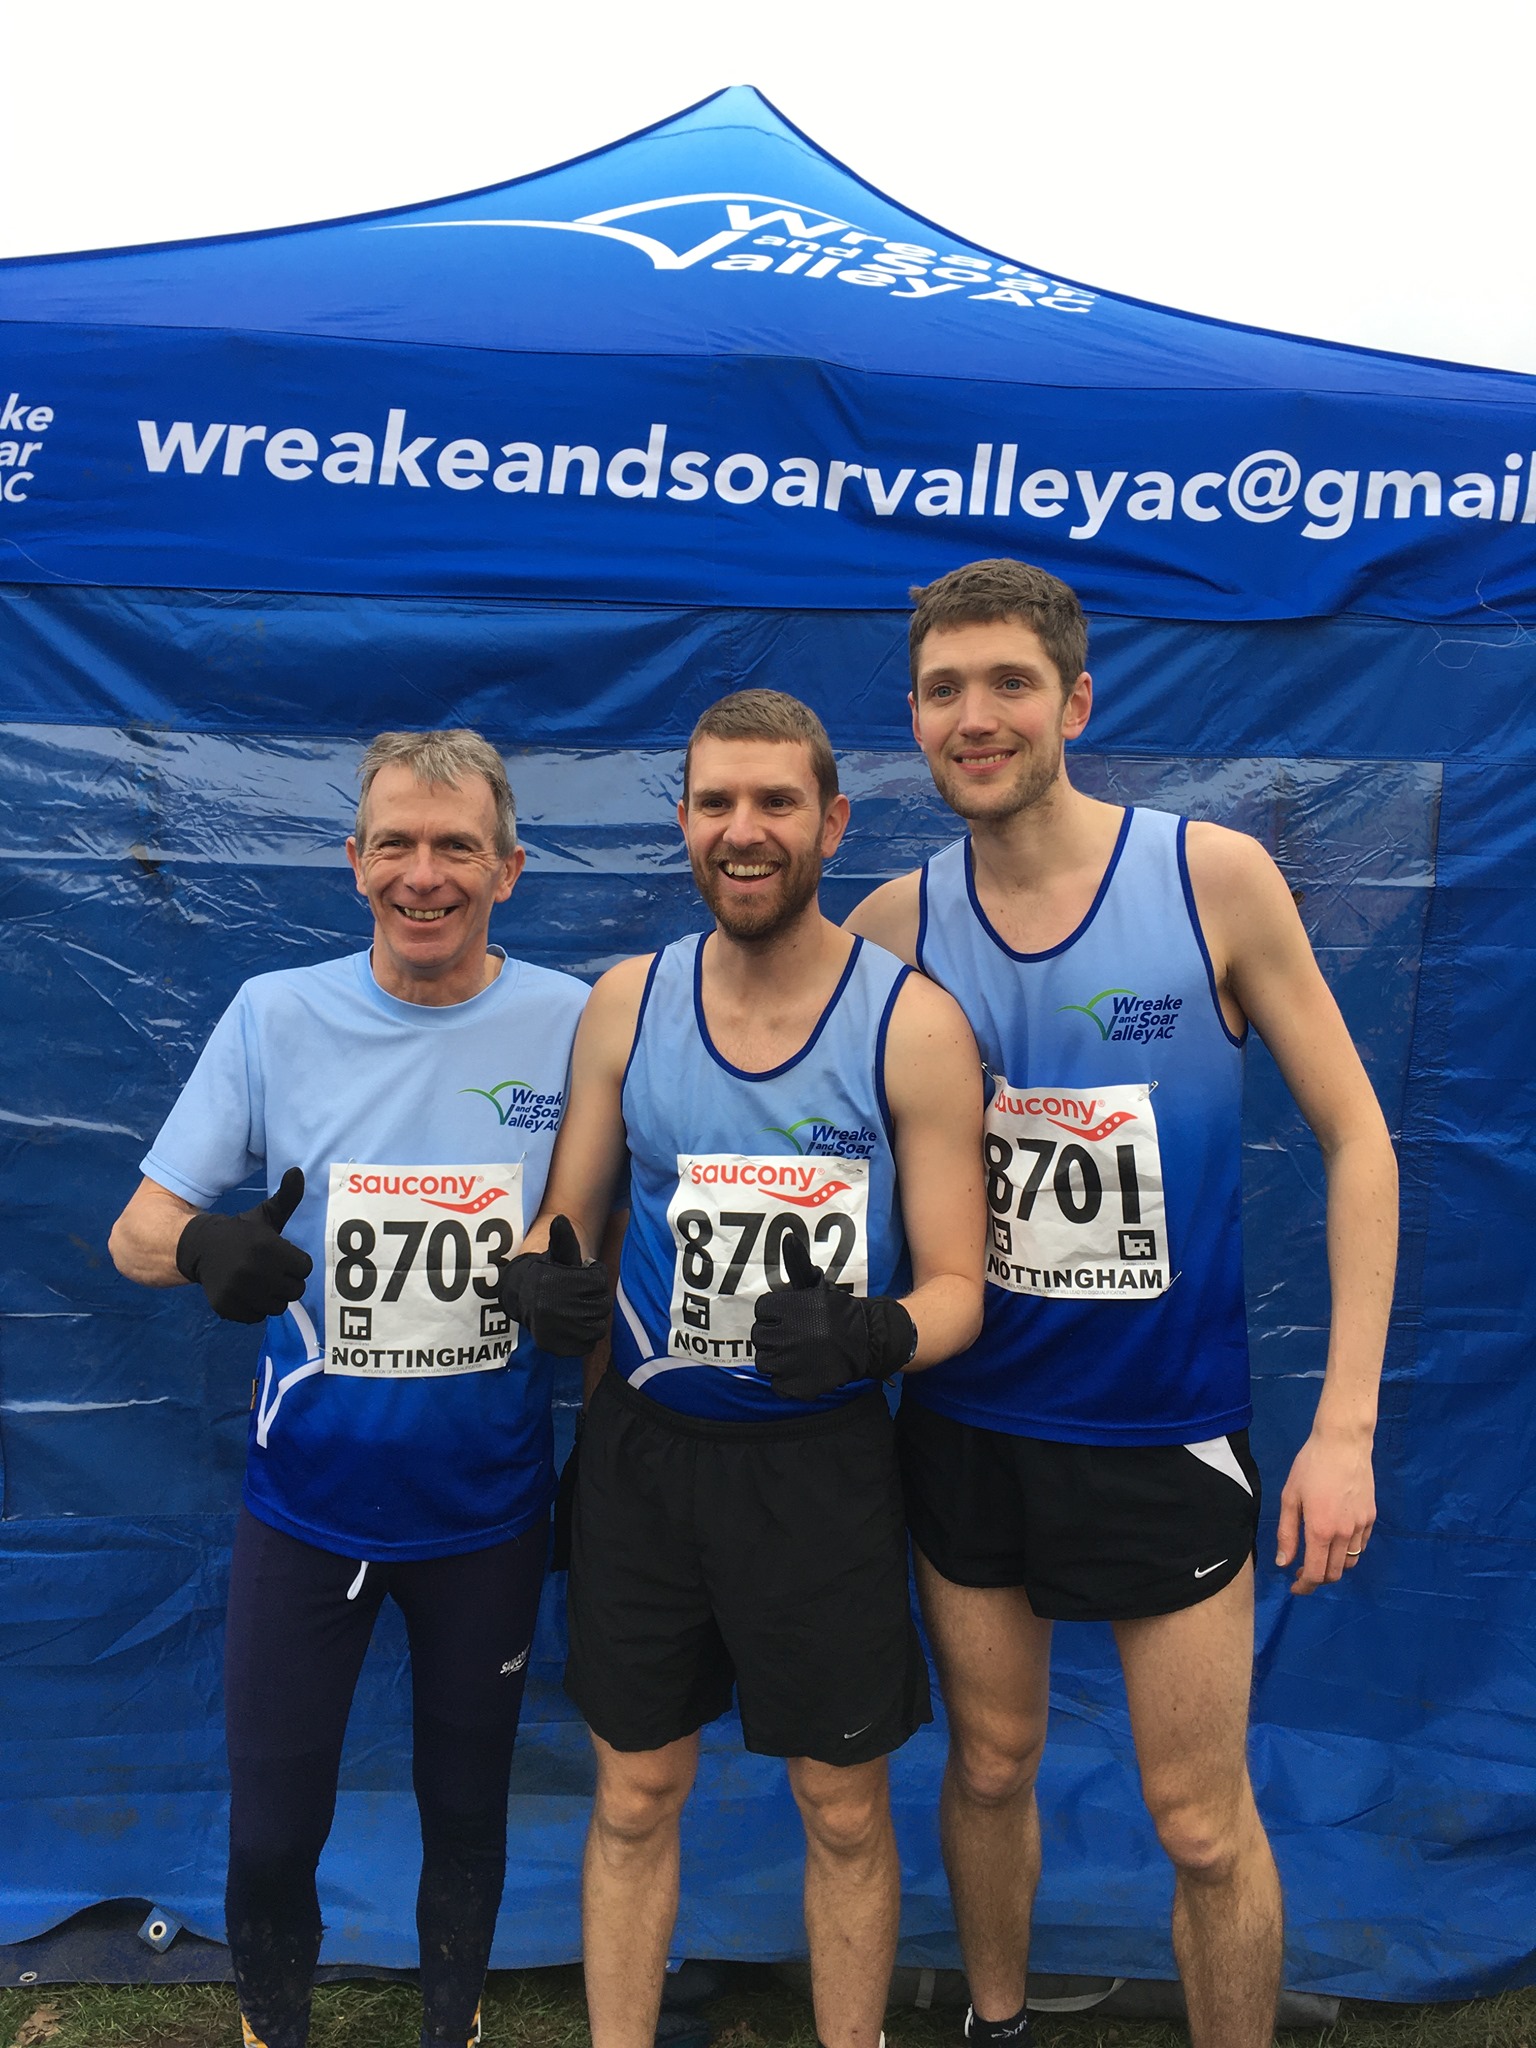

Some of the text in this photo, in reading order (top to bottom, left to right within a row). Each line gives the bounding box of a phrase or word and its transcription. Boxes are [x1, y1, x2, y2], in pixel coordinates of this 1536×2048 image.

[752, 235, 1095, 297] and Soar
[967, 288, 1095, 313] AC
[137, 408, 1536, 540] wreakeandsoarvalleyac@gmail
[1113, 993, 1183, 1014] Wreake
[1118, 1011, 1178, 1029] and Soar
[1153, 1026, 1176, 1040] AC
[515, 1105, 532, 1113] and
[812, 1125, 878, 1142] Wreake
[815, 1142, 836, 1150] and
[835, 1141, 875, 1156] Soar
[348, 1174, 477, 1199] saucony
[691, 1164, 817, 1191] saucony
[985, 1132, 1141, 1224] 8701
[335, 1217, 514, 1303] 8703
[676, 1208, 857, 1296] 8702
[987, 1253, 1164, 1289] NOTTINGHAM
[331, 1340, 513, 1368] NOTTINGHAM
